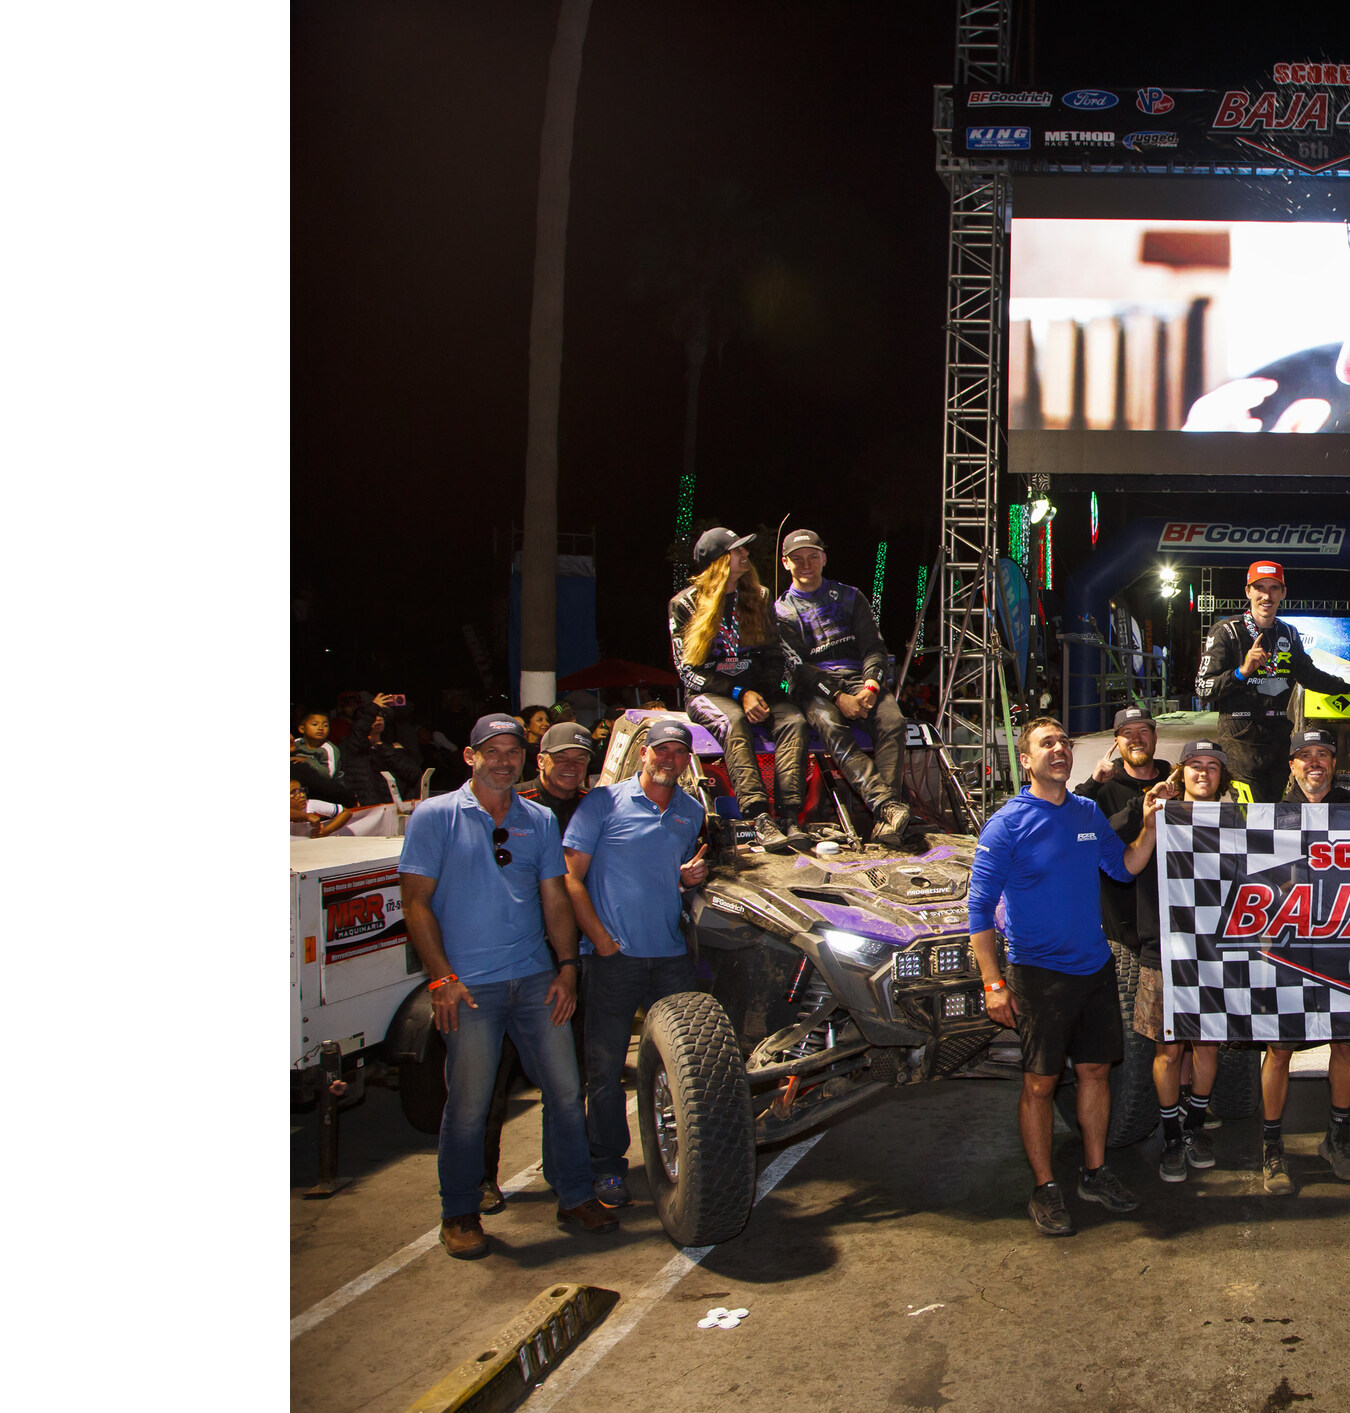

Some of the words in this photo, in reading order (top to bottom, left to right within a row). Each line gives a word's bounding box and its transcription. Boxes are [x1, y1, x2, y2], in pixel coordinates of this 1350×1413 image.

[969, 91, 1053, 104] BFGoodrich
[1073, 92, 1108, 106] Ford
[1212, 90, 1329, 131] BAJA
[969, 128, 1028, 139] KING
[1044, 131, 1115, 142] METHOD
[1300, 141, 1329, 159] 6th
[1161, 523, 1345, 545] BFGoodrich
[1320, 545, 1339, 553] Tires
[906, 887, 949, 896] PROGRESSIVE
[712, 895, 745, 913] BFGoodrich
[326, 893, 385, 941] MRR
[338, 922, 384, 938] MAQUINARIA
